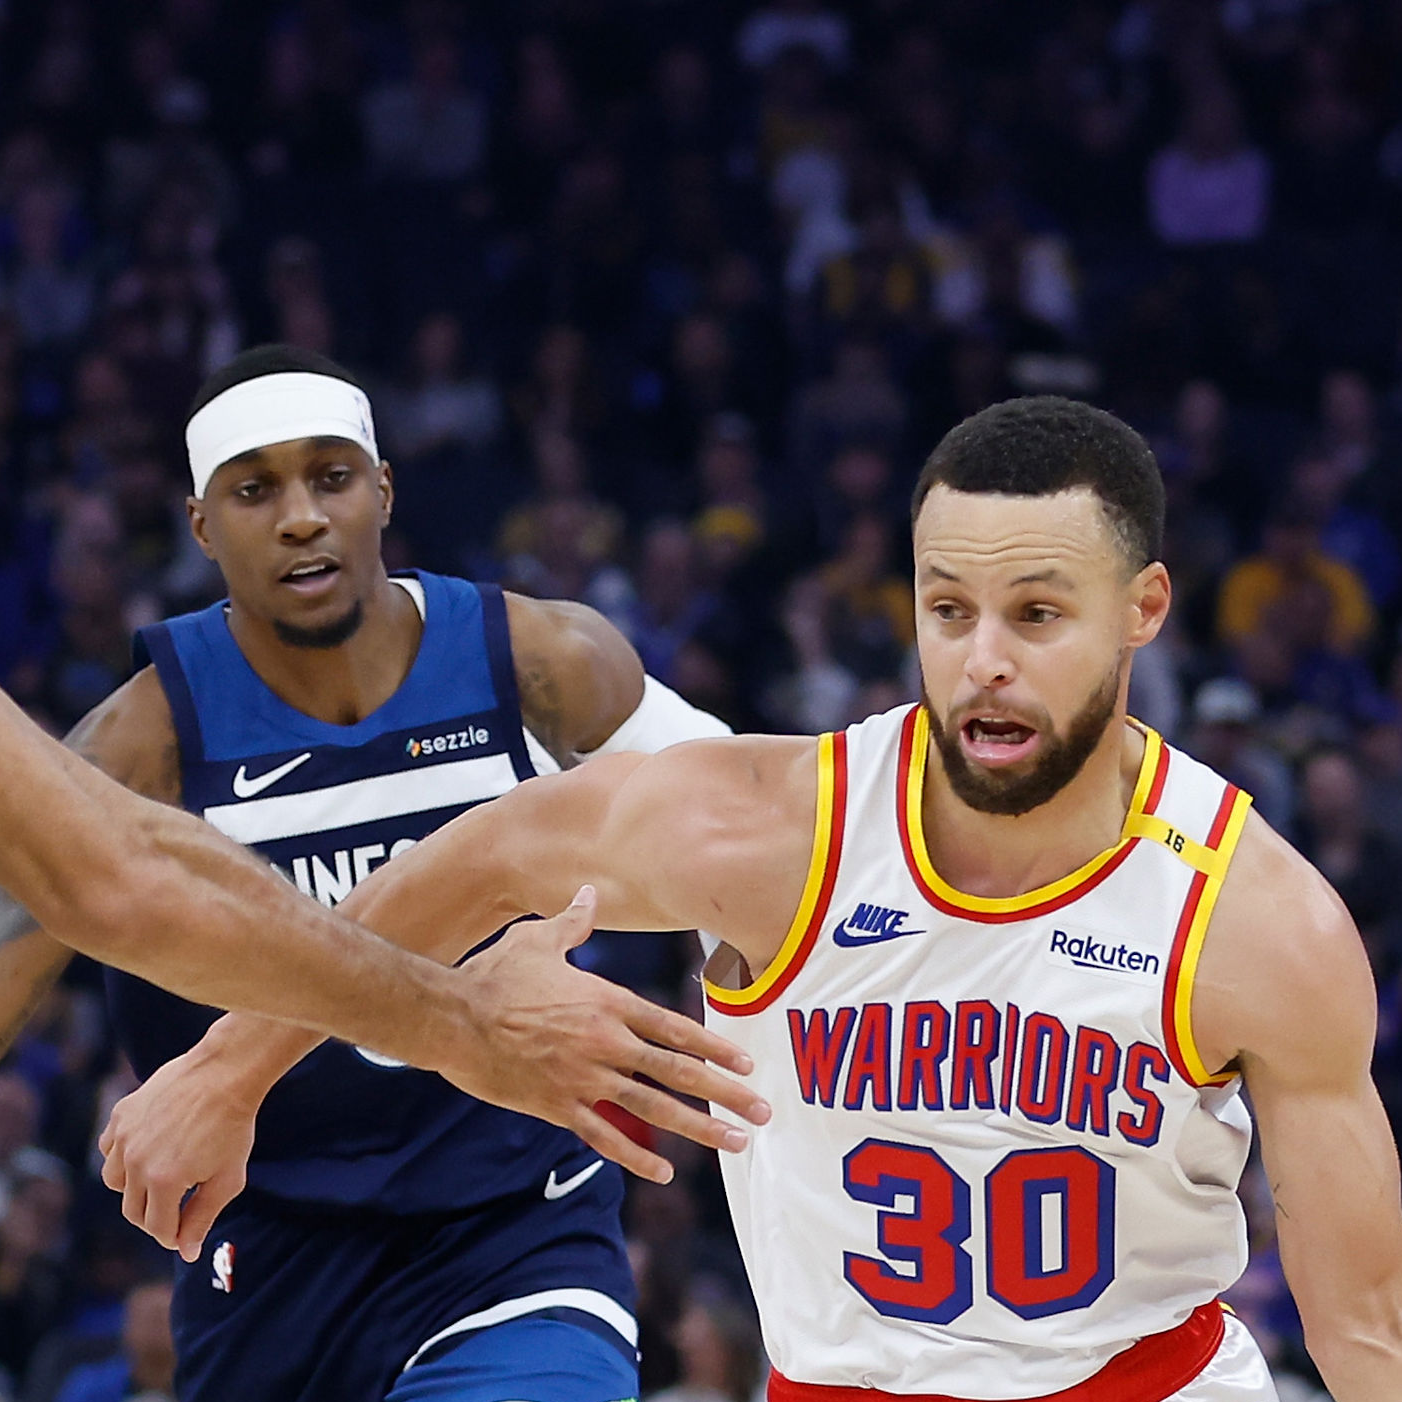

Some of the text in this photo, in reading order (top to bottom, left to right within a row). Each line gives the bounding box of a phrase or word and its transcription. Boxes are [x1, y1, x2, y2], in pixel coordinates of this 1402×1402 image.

[421, 725, 490, 755] sezzle
[1164, 828, 1186, 854] 16
[847, 902, 909, 935] NIKE
[1050, 929, 1160, 975] Rakuten
[786, 1000, 1170, 1147] WARRIORS
[842, 1137, 1116, 1325] 30
